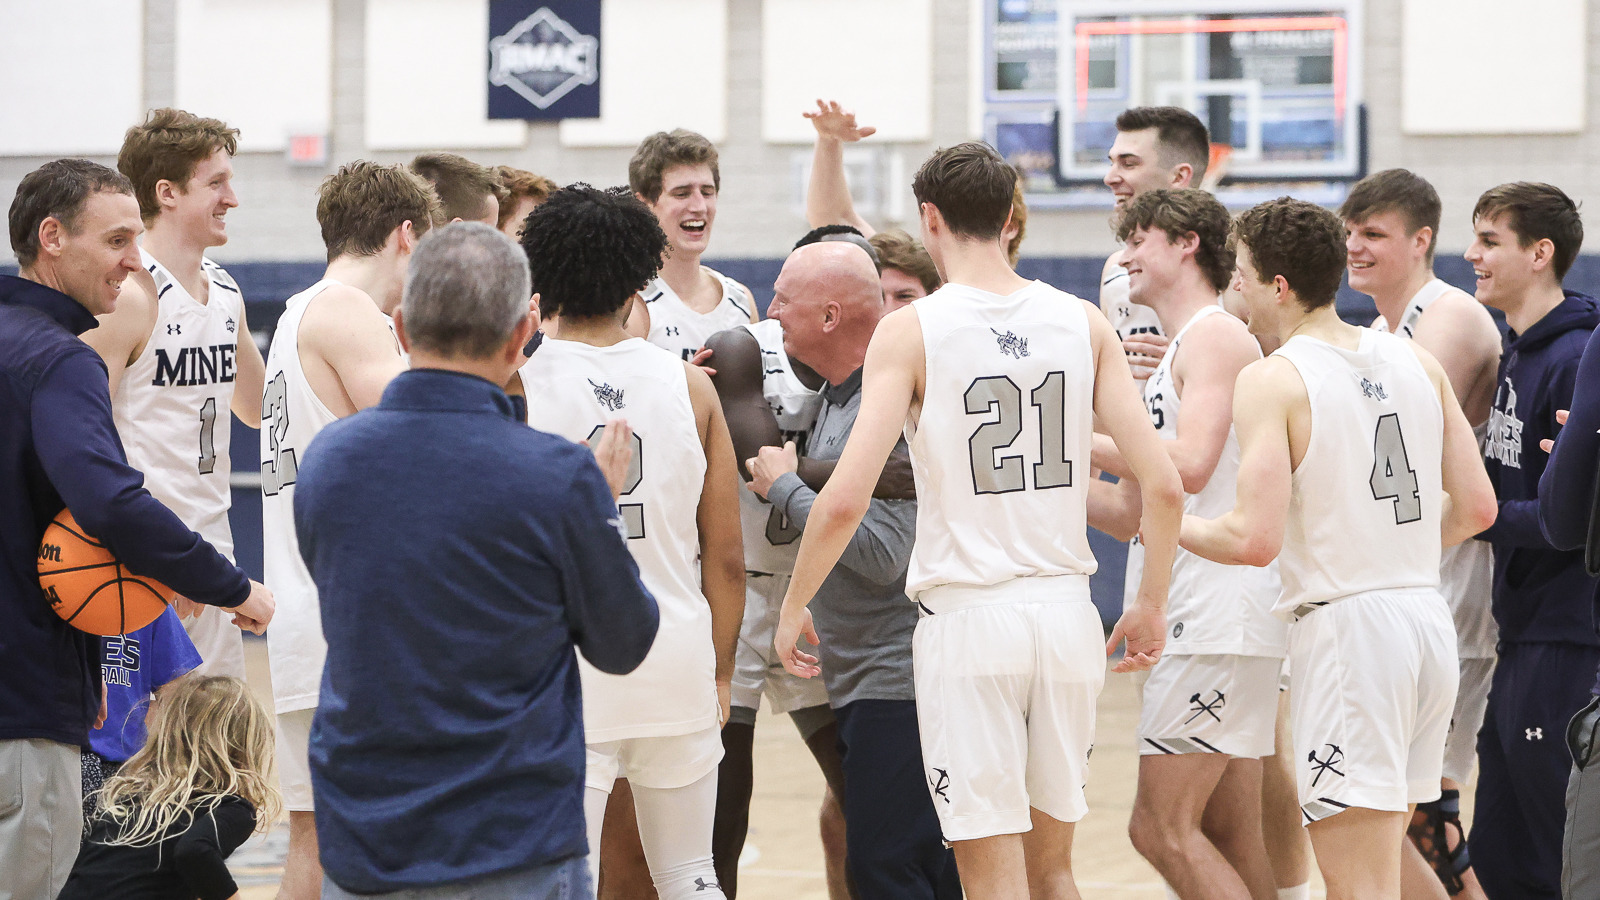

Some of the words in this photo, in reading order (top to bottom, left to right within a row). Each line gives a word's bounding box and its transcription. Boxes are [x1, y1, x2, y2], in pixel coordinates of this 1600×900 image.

[152, 344, 237, 386] MINE
[198, 397, 216, 475] 1
[964, 371, 1072, 495] 21
[1369, 413, 1421, 525] 4
